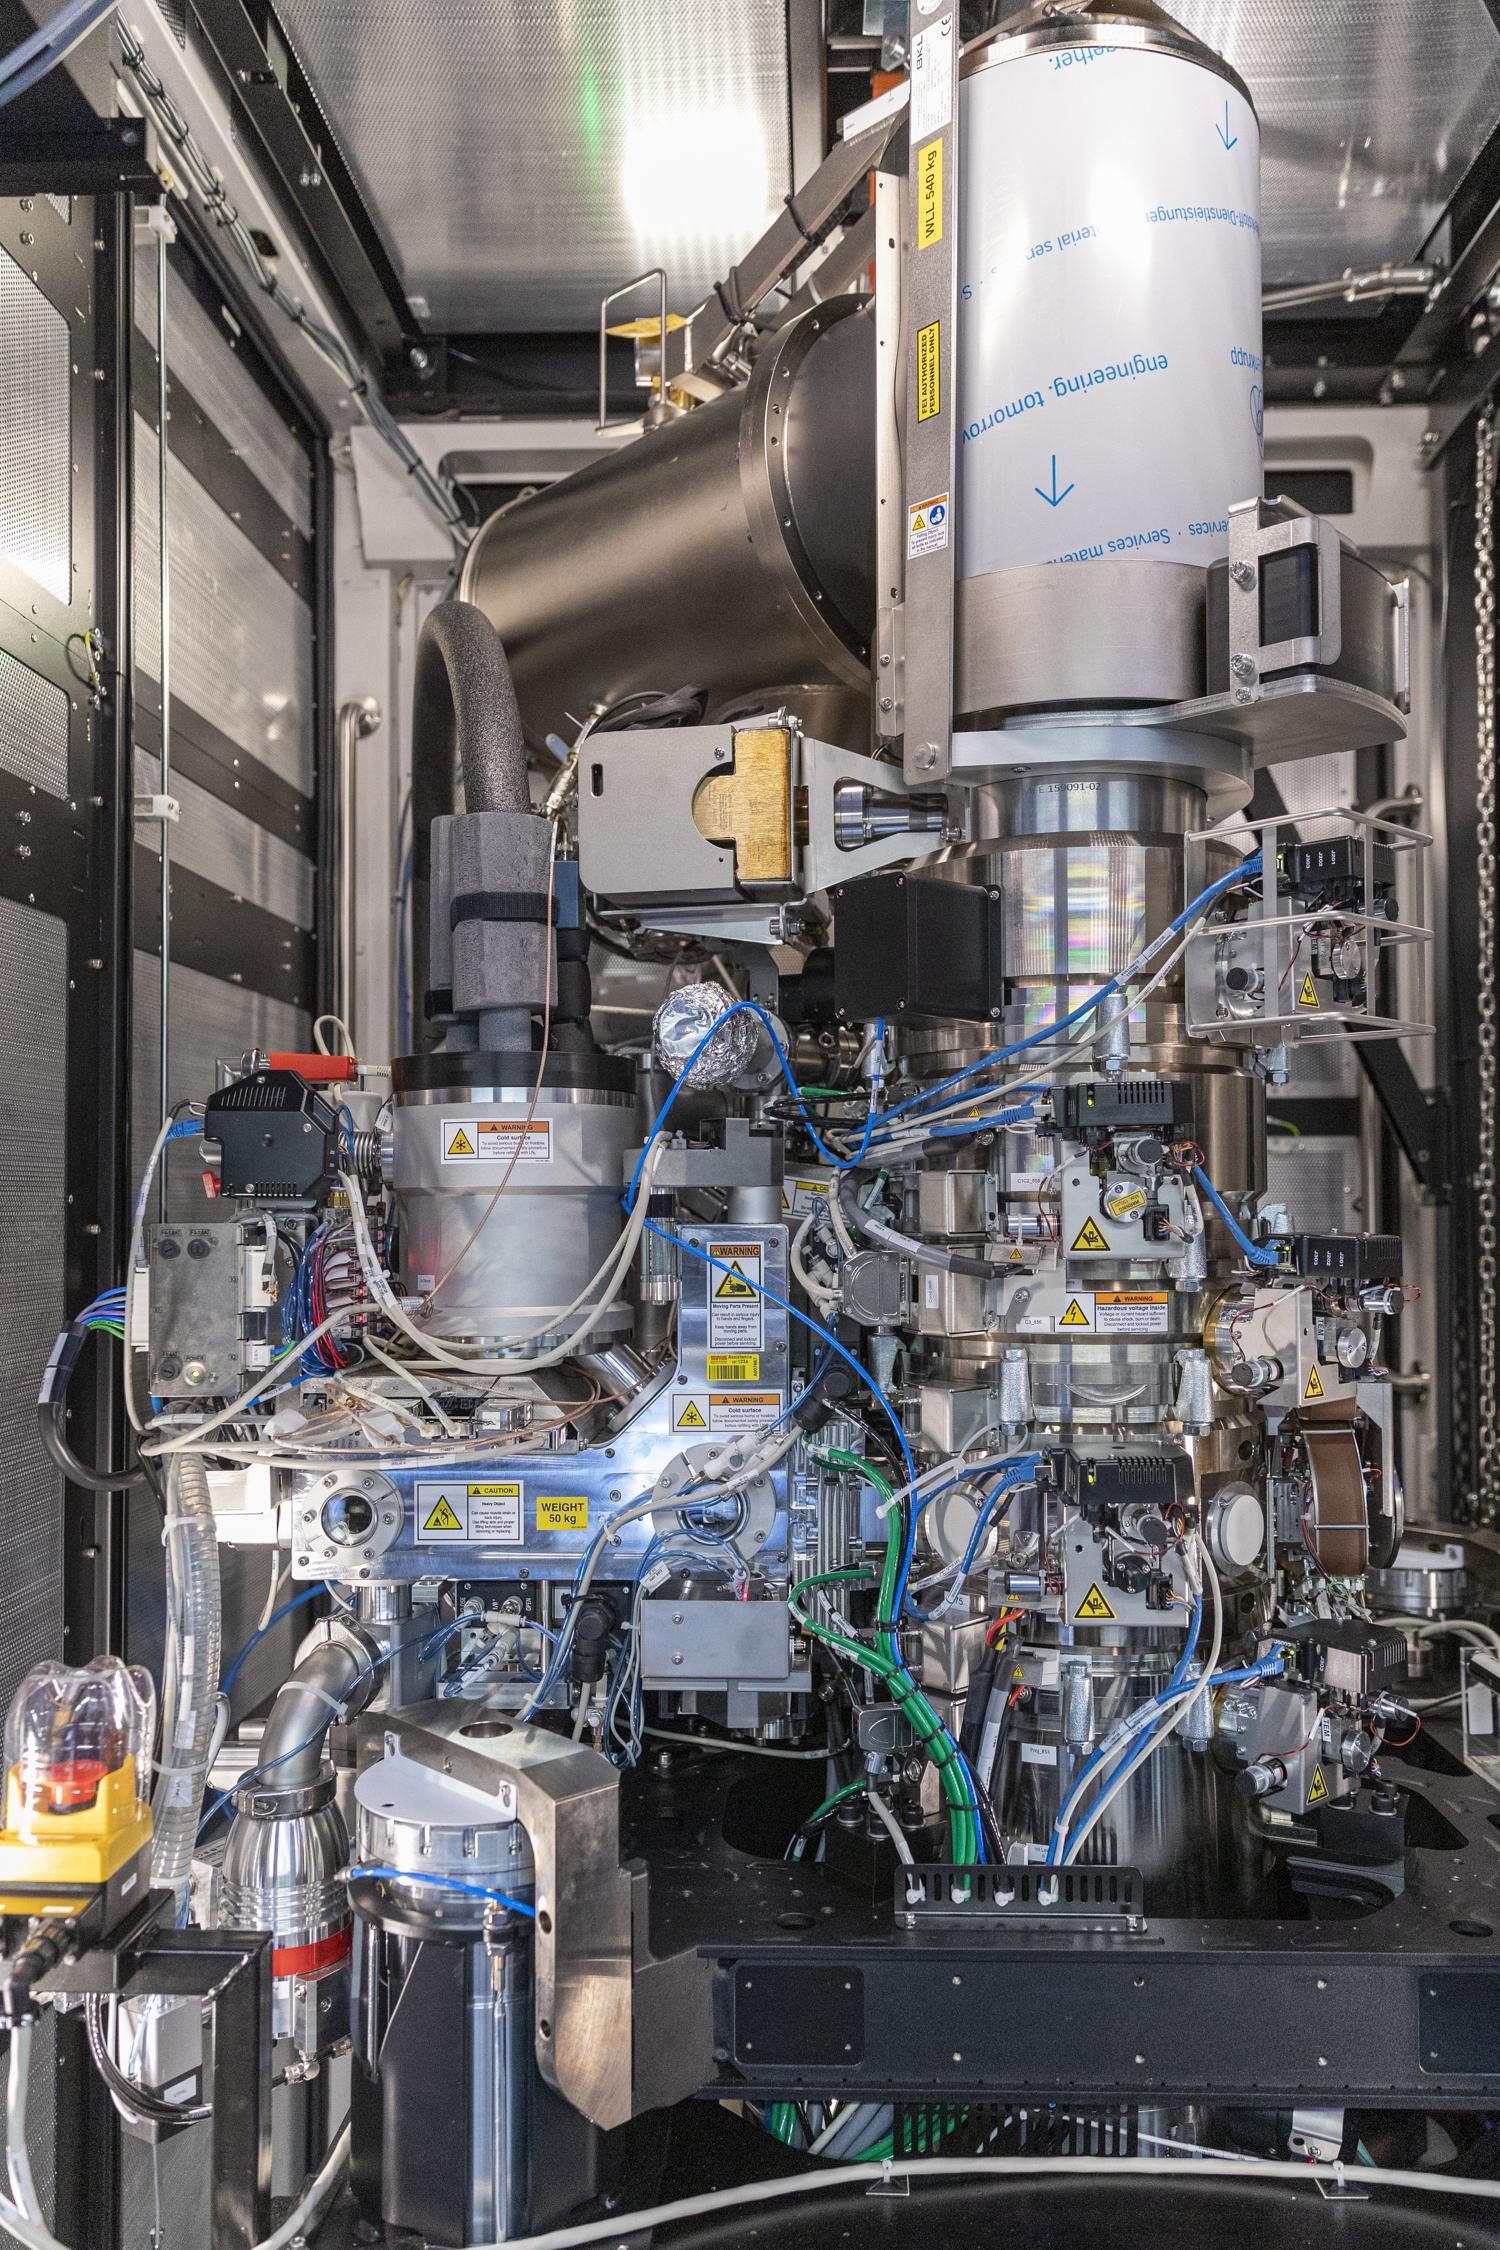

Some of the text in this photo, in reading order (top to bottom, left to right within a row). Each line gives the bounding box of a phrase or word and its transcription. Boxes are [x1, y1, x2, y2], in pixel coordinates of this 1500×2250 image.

[925, 150, 937, 239] WLL 540 kg
[1047, 353, 1169, 399] engineering.
[1107, 528, 1171, 554] Services
[1047, 782, 1103, 793] 159091-02
[720, 1246, 759, 1255] WARNING
[541, 1502, 585, 1512] WEIGHT
[549, 1514, 576, 1524] 50 kg
